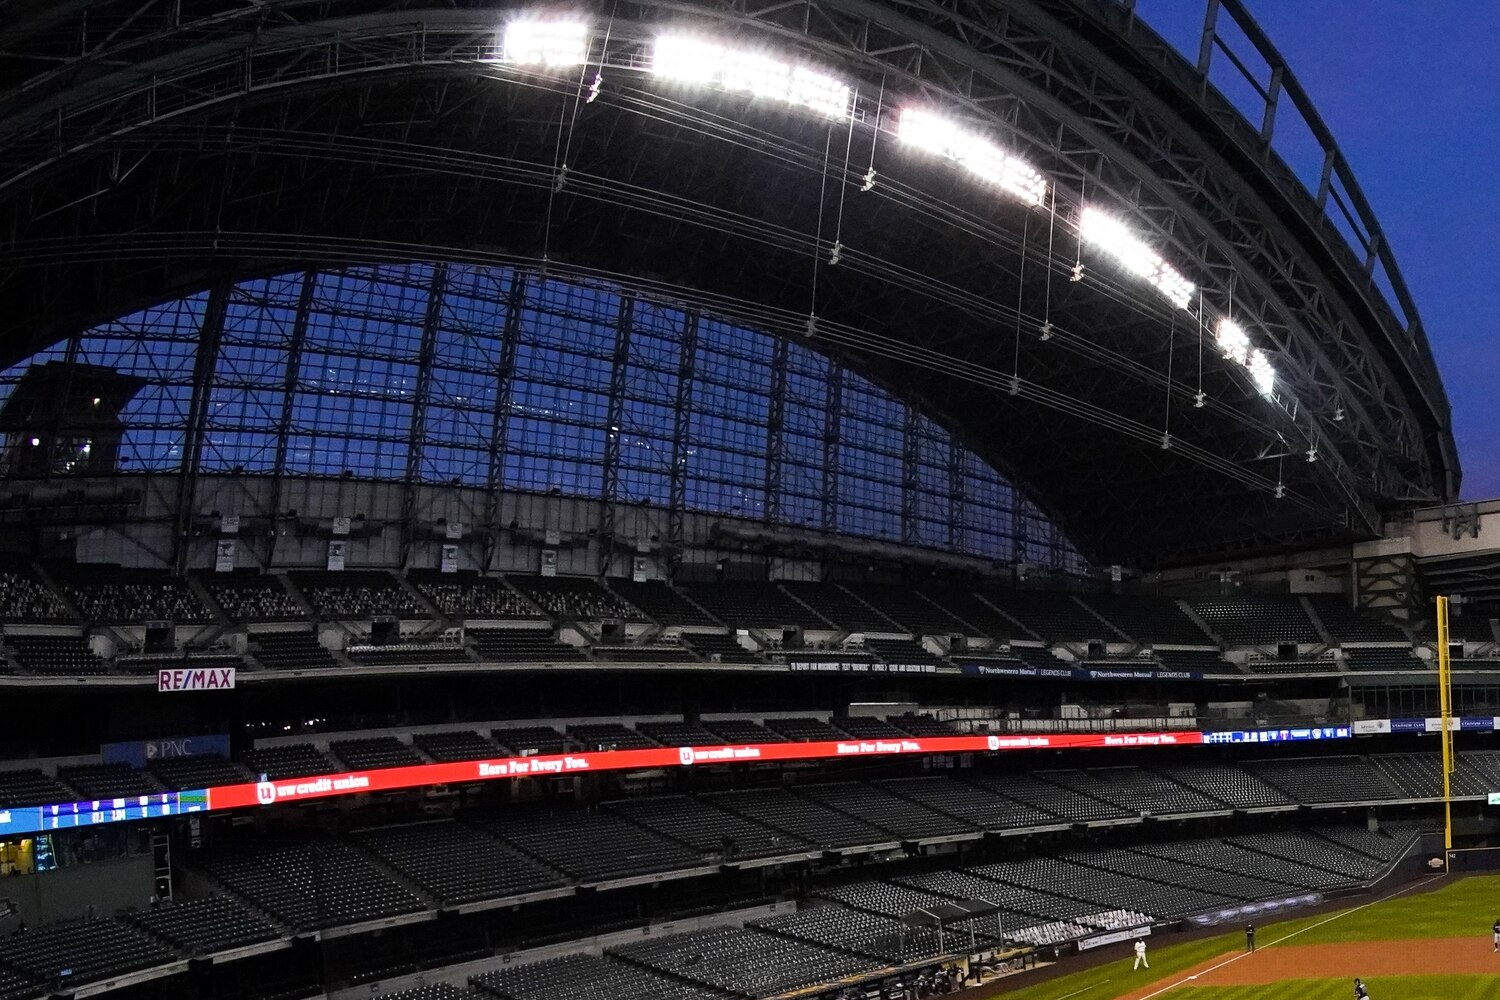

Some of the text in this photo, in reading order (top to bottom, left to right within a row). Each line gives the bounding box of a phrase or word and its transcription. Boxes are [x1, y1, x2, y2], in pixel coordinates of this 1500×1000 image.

[159, 669, 231, 691] RE/MAX
[161, 739, 193, 757] PNC
[709, 749, 734, 759] credit
[837, 743, 860, 754] Here
[860, 743, 875, 753] For
[876, 742, 901, 753] Every
[478, 757, 589, 776] Here For Every You.
[296, 780, 333, 796] credit
[333, 776, 369, 791] union
